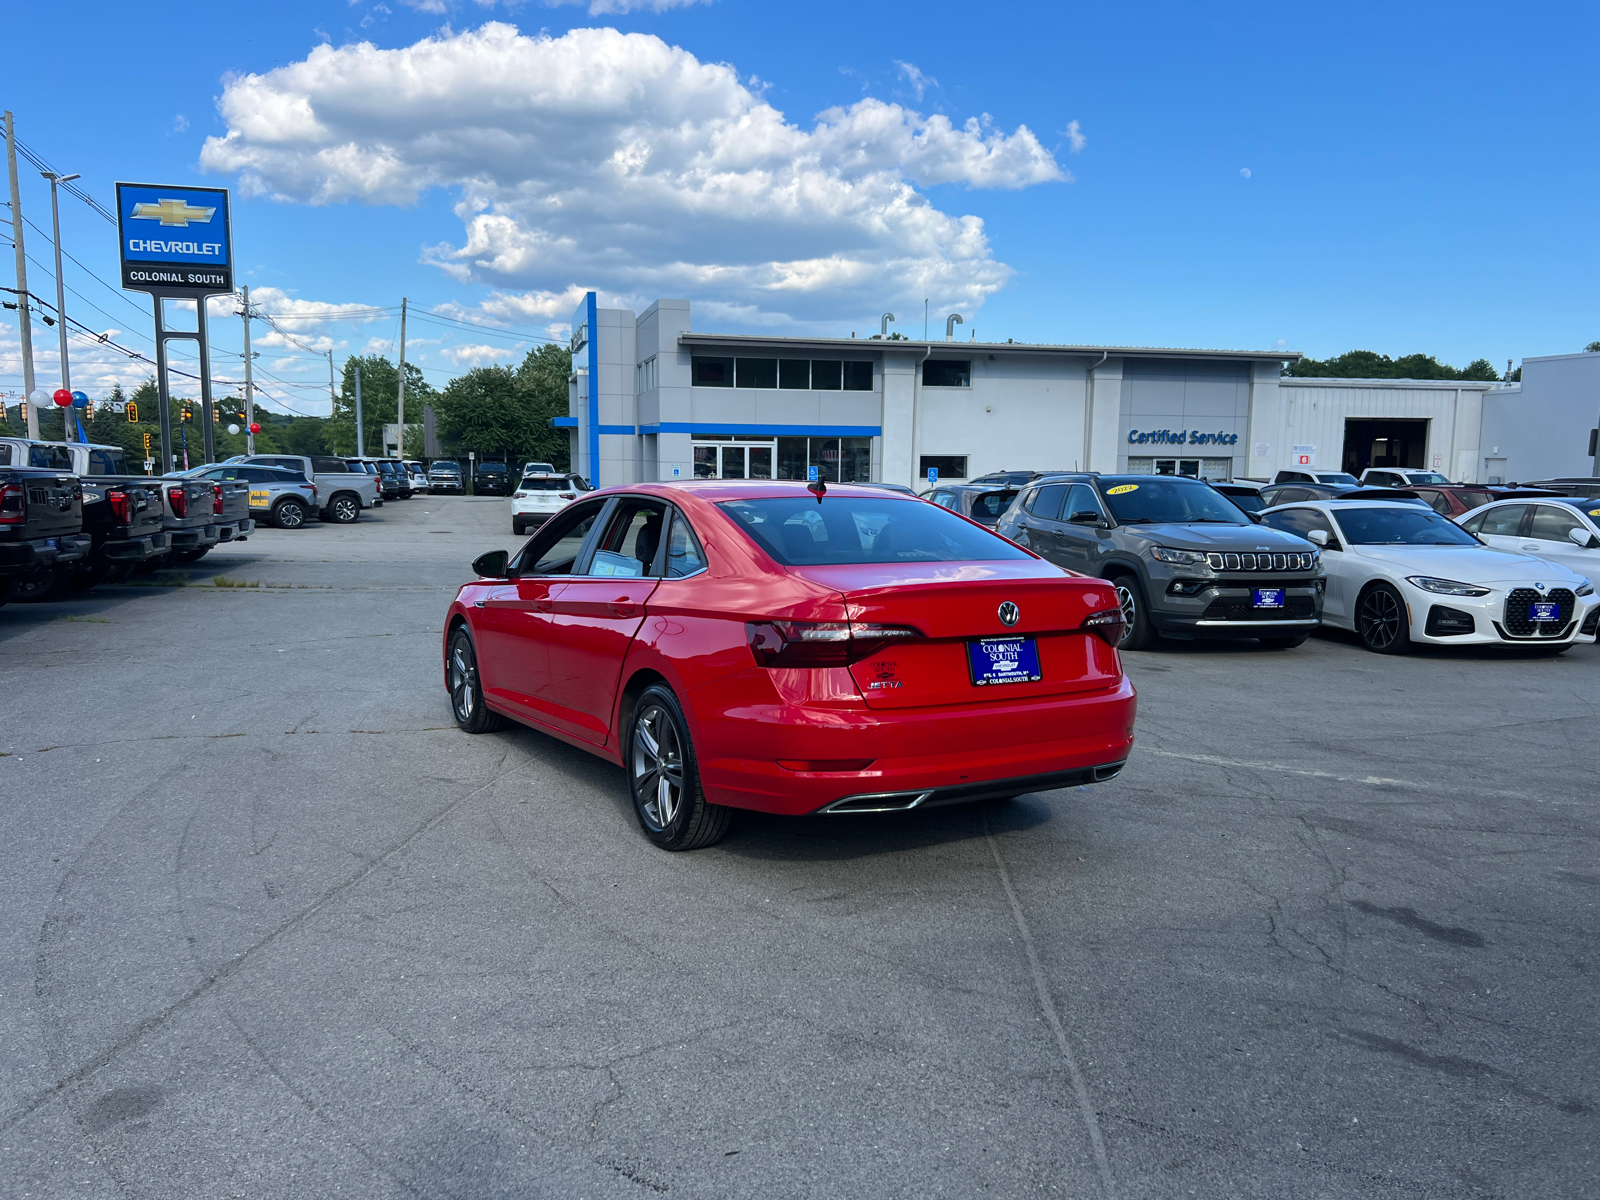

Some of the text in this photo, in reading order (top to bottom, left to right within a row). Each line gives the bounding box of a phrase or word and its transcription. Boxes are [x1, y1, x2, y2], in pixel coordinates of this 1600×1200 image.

[129, 239, 222, 256] CHEVROLET
[130, 271, 224, 284] COLONIAL SOUTH
[1129, 429, 1239, 445] Certified Service
[983, 643, 1023, 653] COLONIAL
[989, 652, 1019, 662] SOUTH
[867, 681, 904, 690] JETTA
